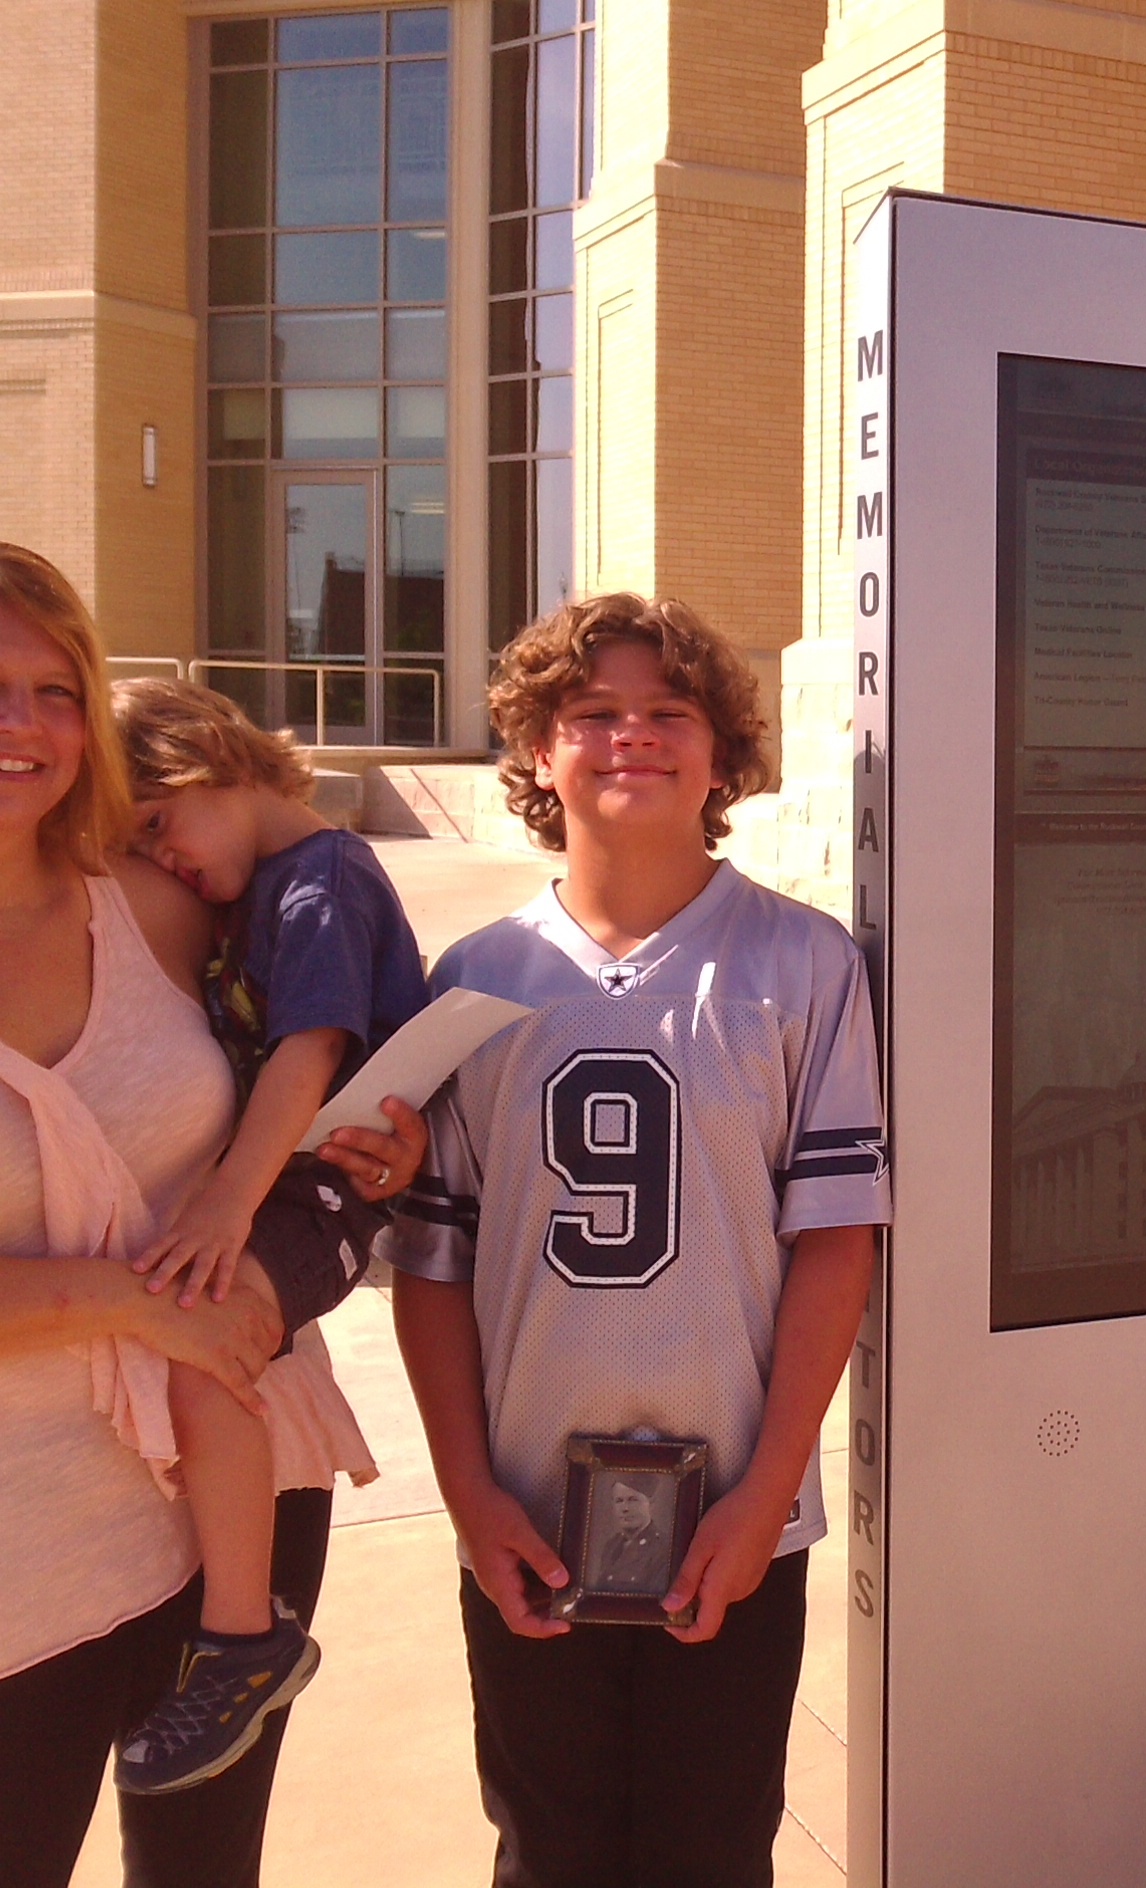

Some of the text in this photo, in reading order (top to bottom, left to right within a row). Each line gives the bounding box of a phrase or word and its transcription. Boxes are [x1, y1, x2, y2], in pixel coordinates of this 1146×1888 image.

[857, 329, 884, 931] MEMORIAL
[541, 1047, 682, 1290] 9
[853, 1288, 877, 1618] TORS
